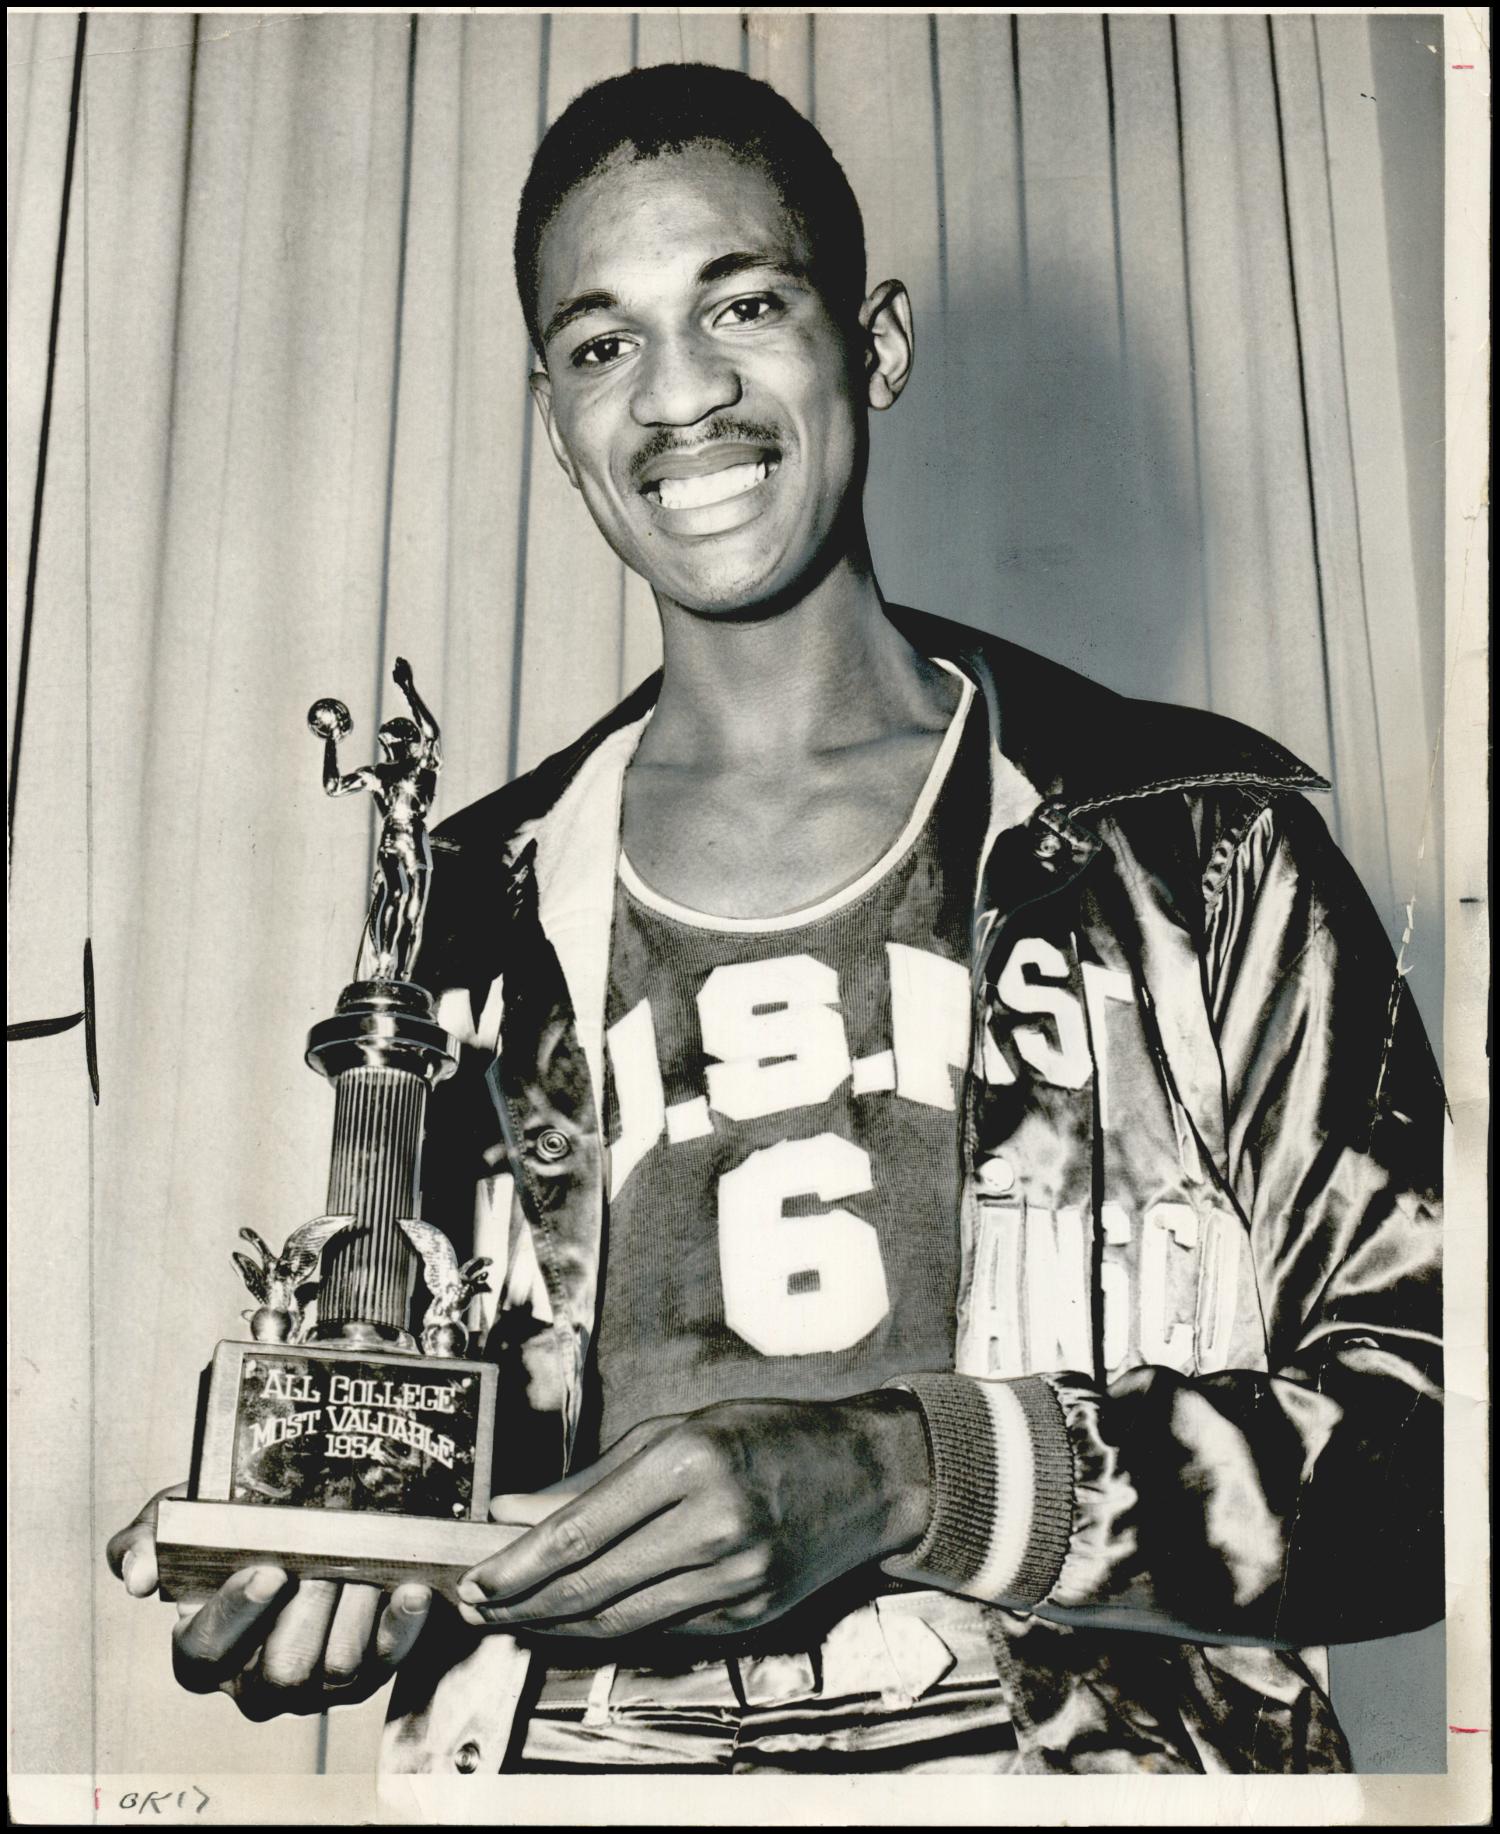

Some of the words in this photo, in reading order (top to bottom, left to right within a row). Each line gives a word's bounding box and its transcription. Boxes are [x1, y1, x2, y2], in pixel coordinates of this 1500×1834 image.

[717, 1132, 890, 1356] 6
[260, 1369, 321, 1403] ALL
[328, 1375, 456, 1413] COLLEGE
[250, 1409, 322, 1455] MOST
[326, 1406, 455, 1469] VALUABLE
[324, 1433, 385, 1459] 1954
